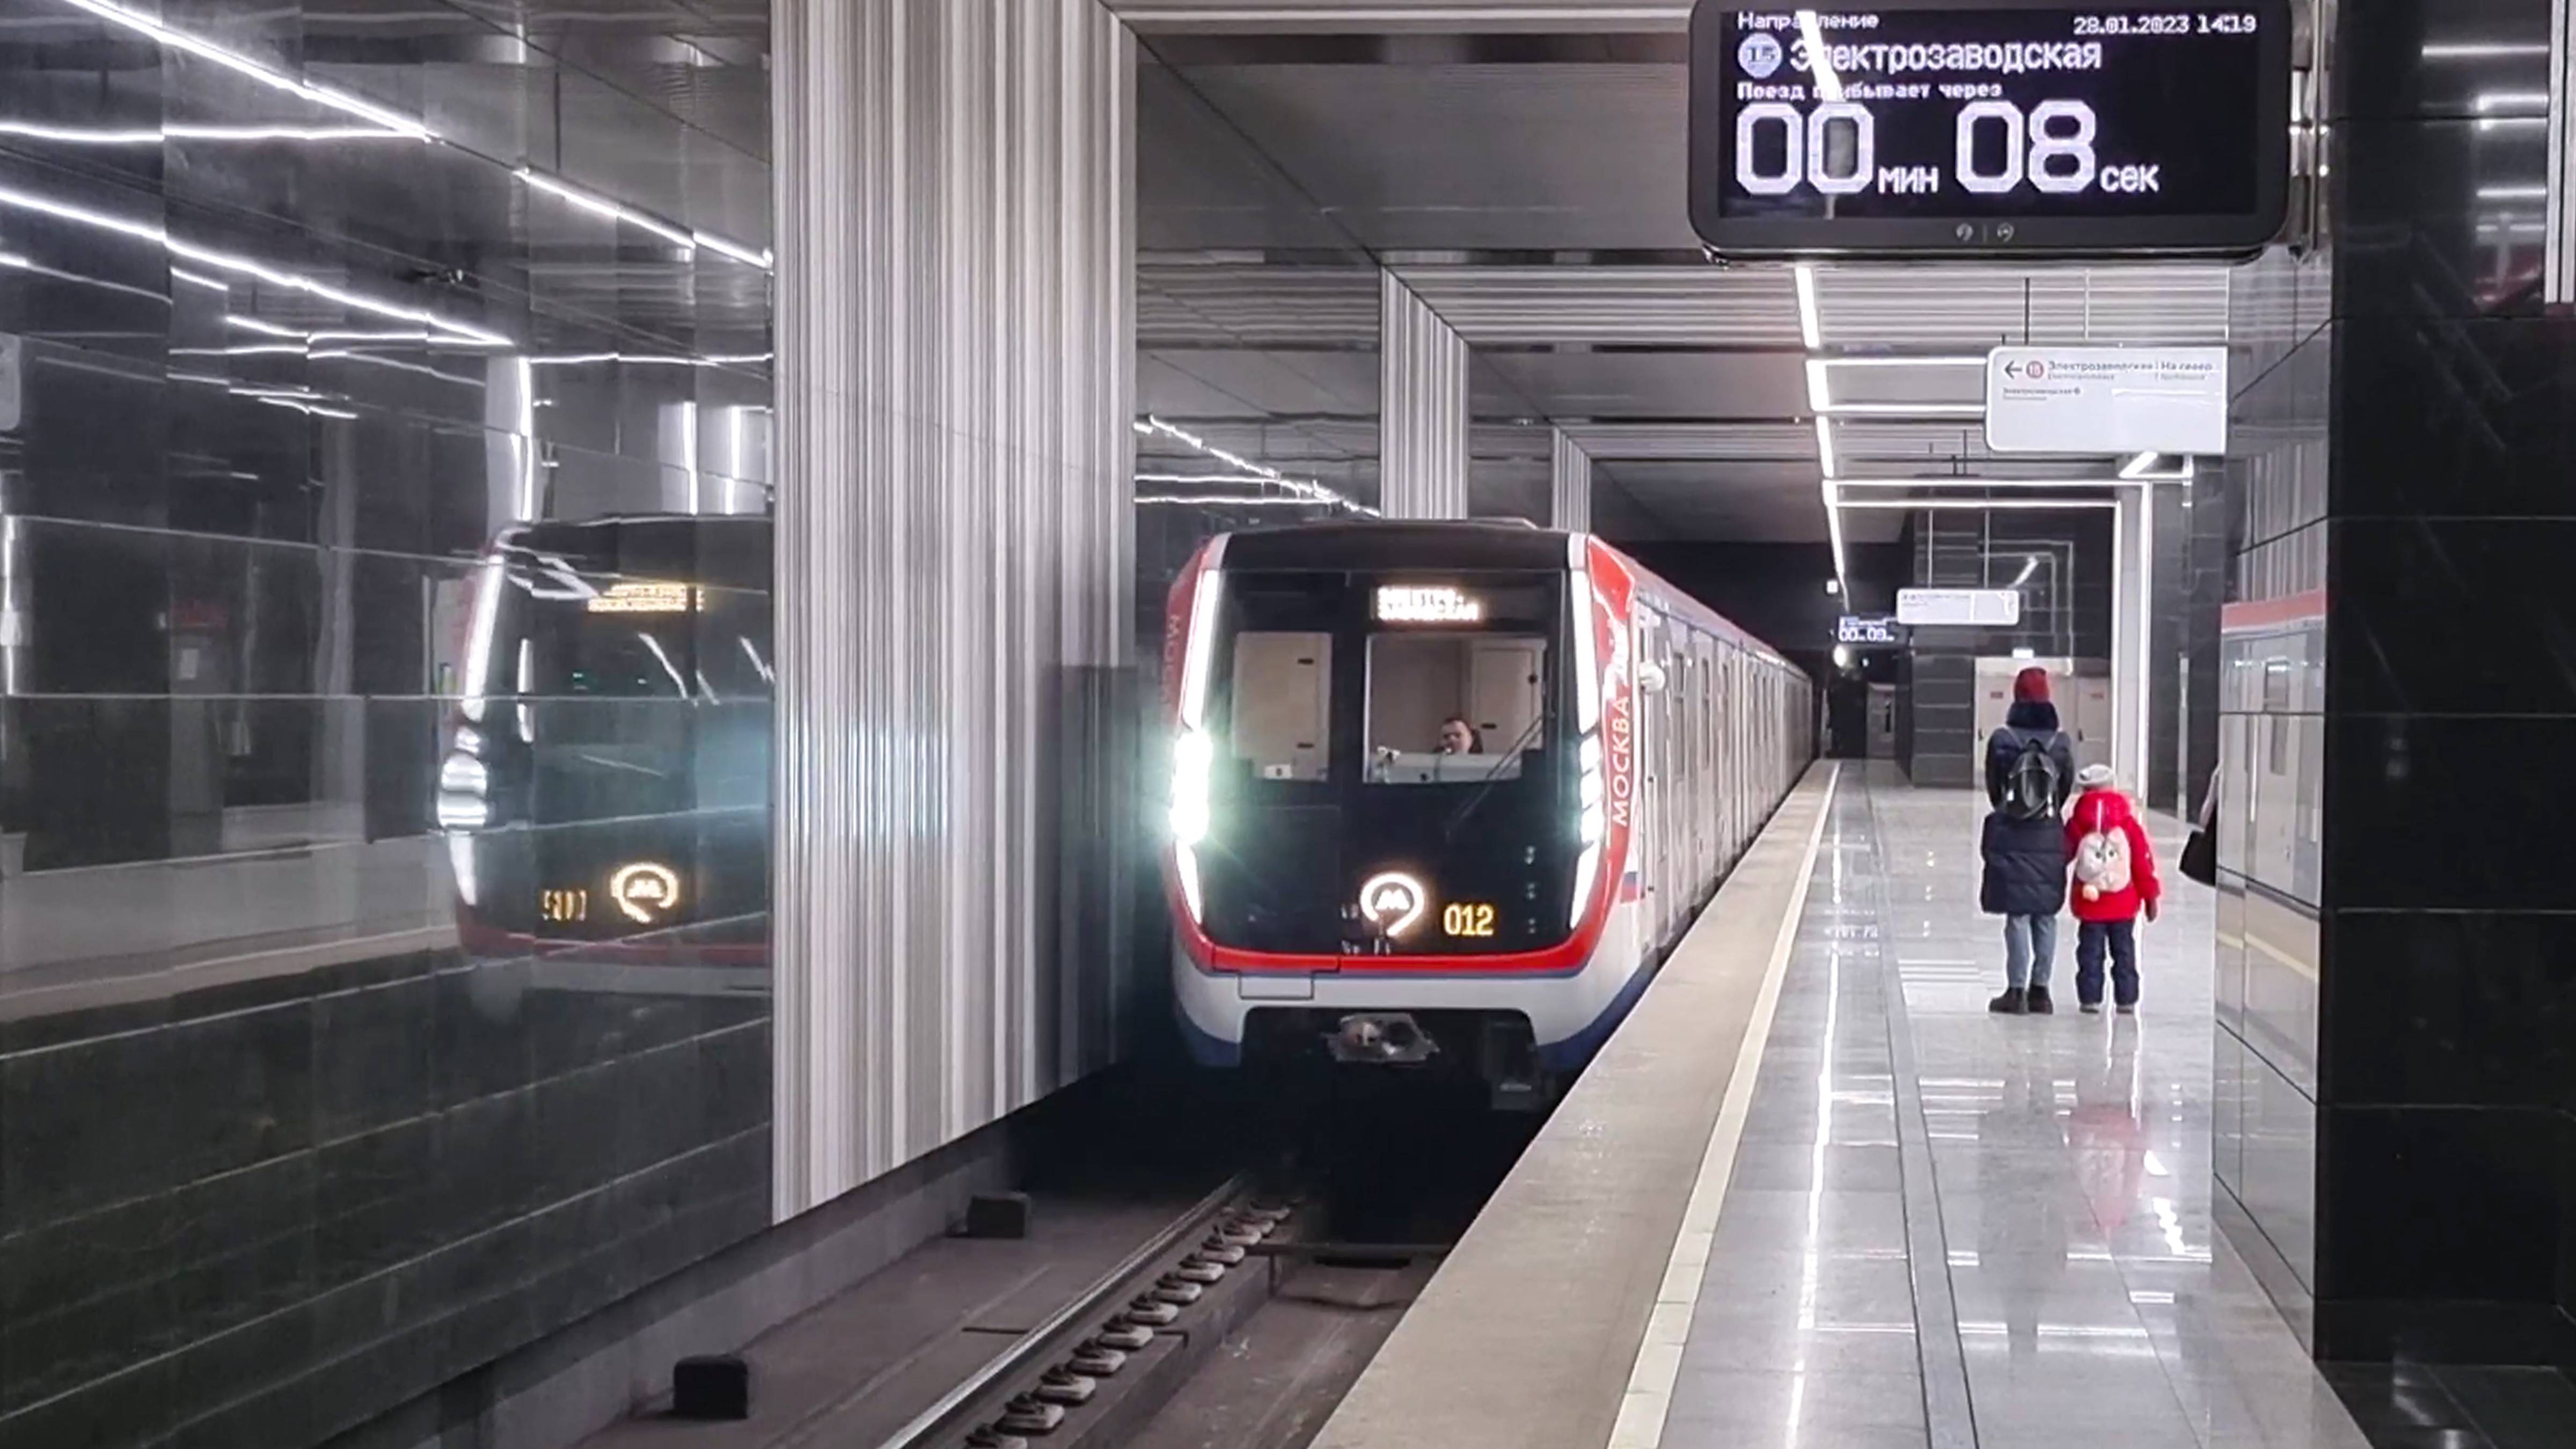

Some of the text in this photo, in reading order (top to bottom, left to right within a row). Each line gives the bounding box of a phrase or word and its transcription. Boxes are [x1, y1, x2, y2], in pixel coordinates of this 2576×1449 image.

[1738, 12, 1879, 30] Напраление
[2074, 14, 2256, 34] 28.01.2023 14:19
[1746, 39, 2102, 74] 15 Эектрозаводская
[1737, 81, 1805, 100] Поезд
[1938, 83, 2002, 99] через
[1736, 100, 2159, 194] 00 мин 08 сек
[1612, 696, 1630, 827] МОСКВА
[1444, 903, 1494, 936] 012
